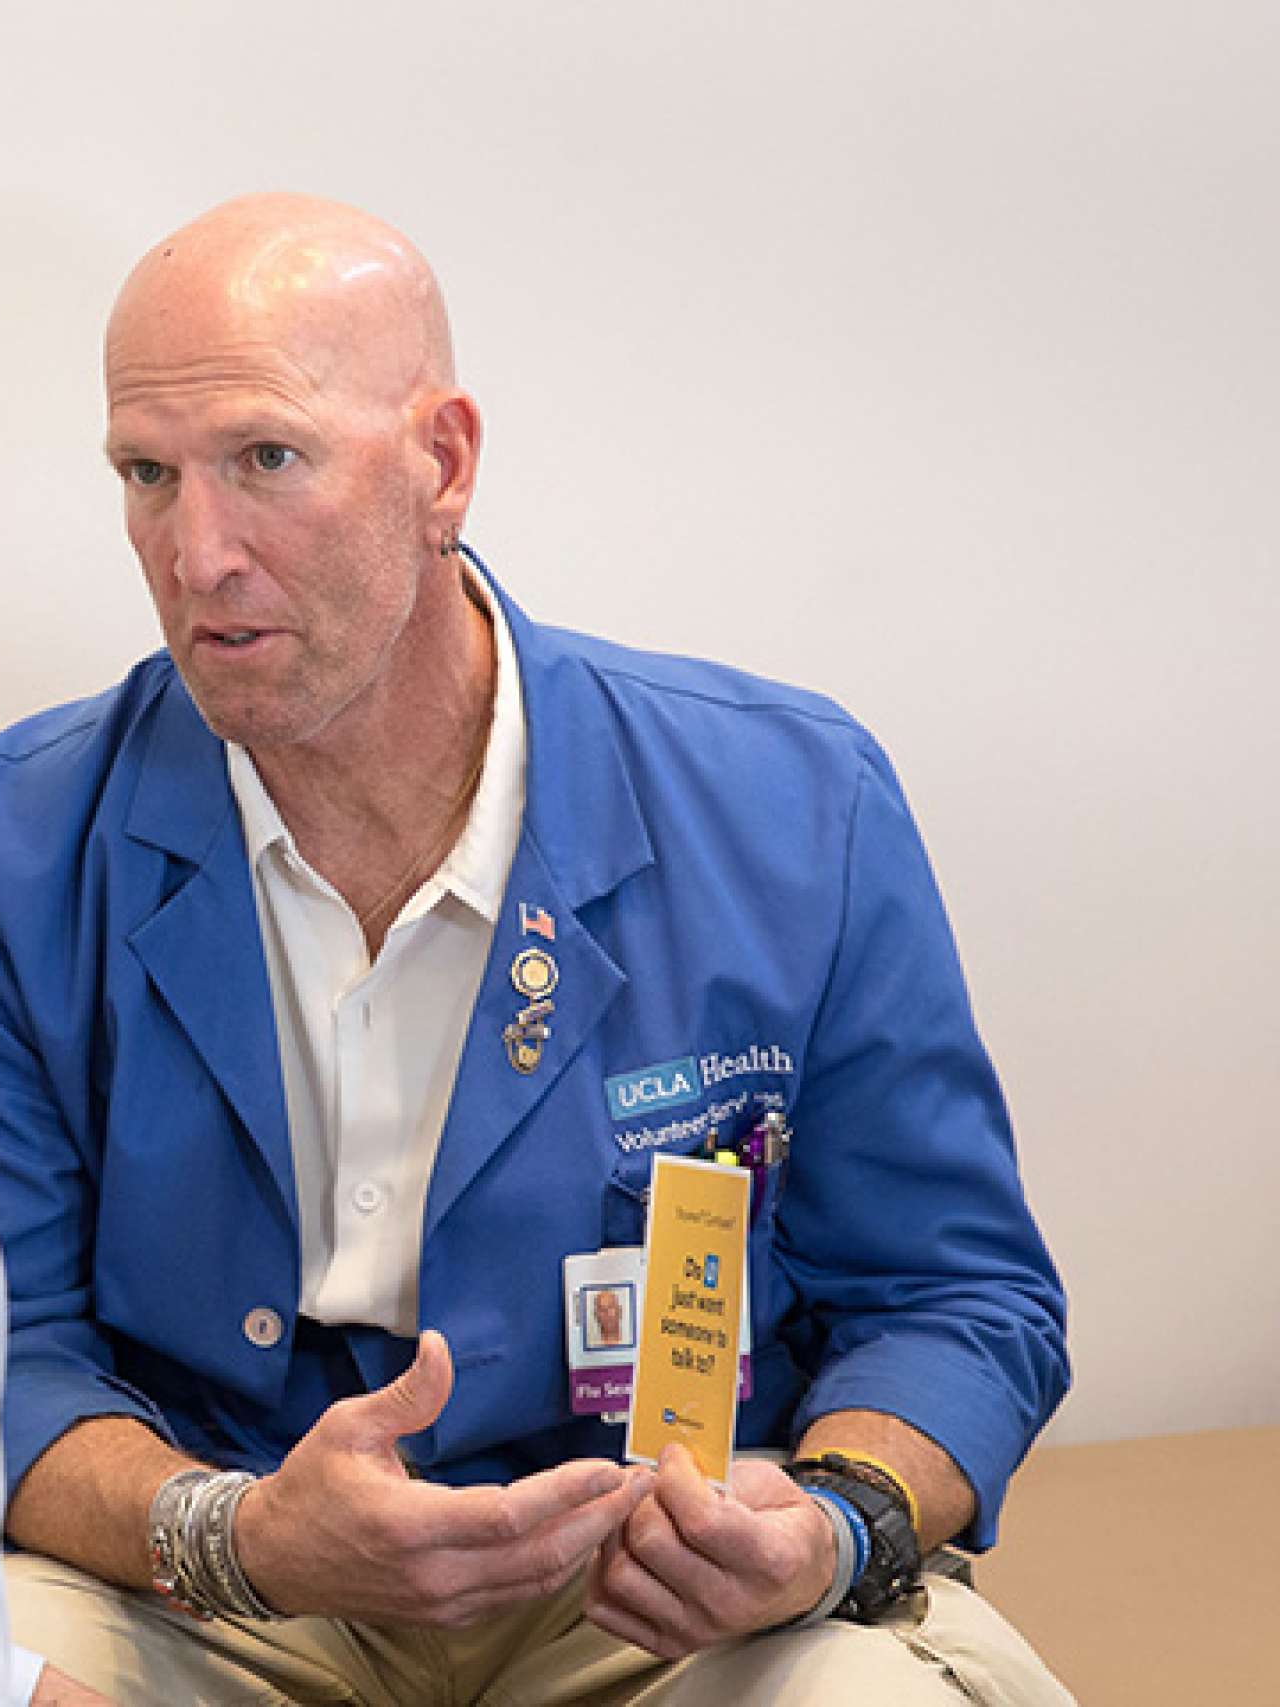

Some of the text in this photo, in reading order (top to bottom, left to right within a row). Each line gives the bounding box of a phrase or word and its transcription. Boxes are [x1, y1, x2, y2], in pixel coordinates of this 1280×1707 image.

[619, 1045, 793, 1106] UCLA Health
[615, 1113, 708, 1151] Volunteer
